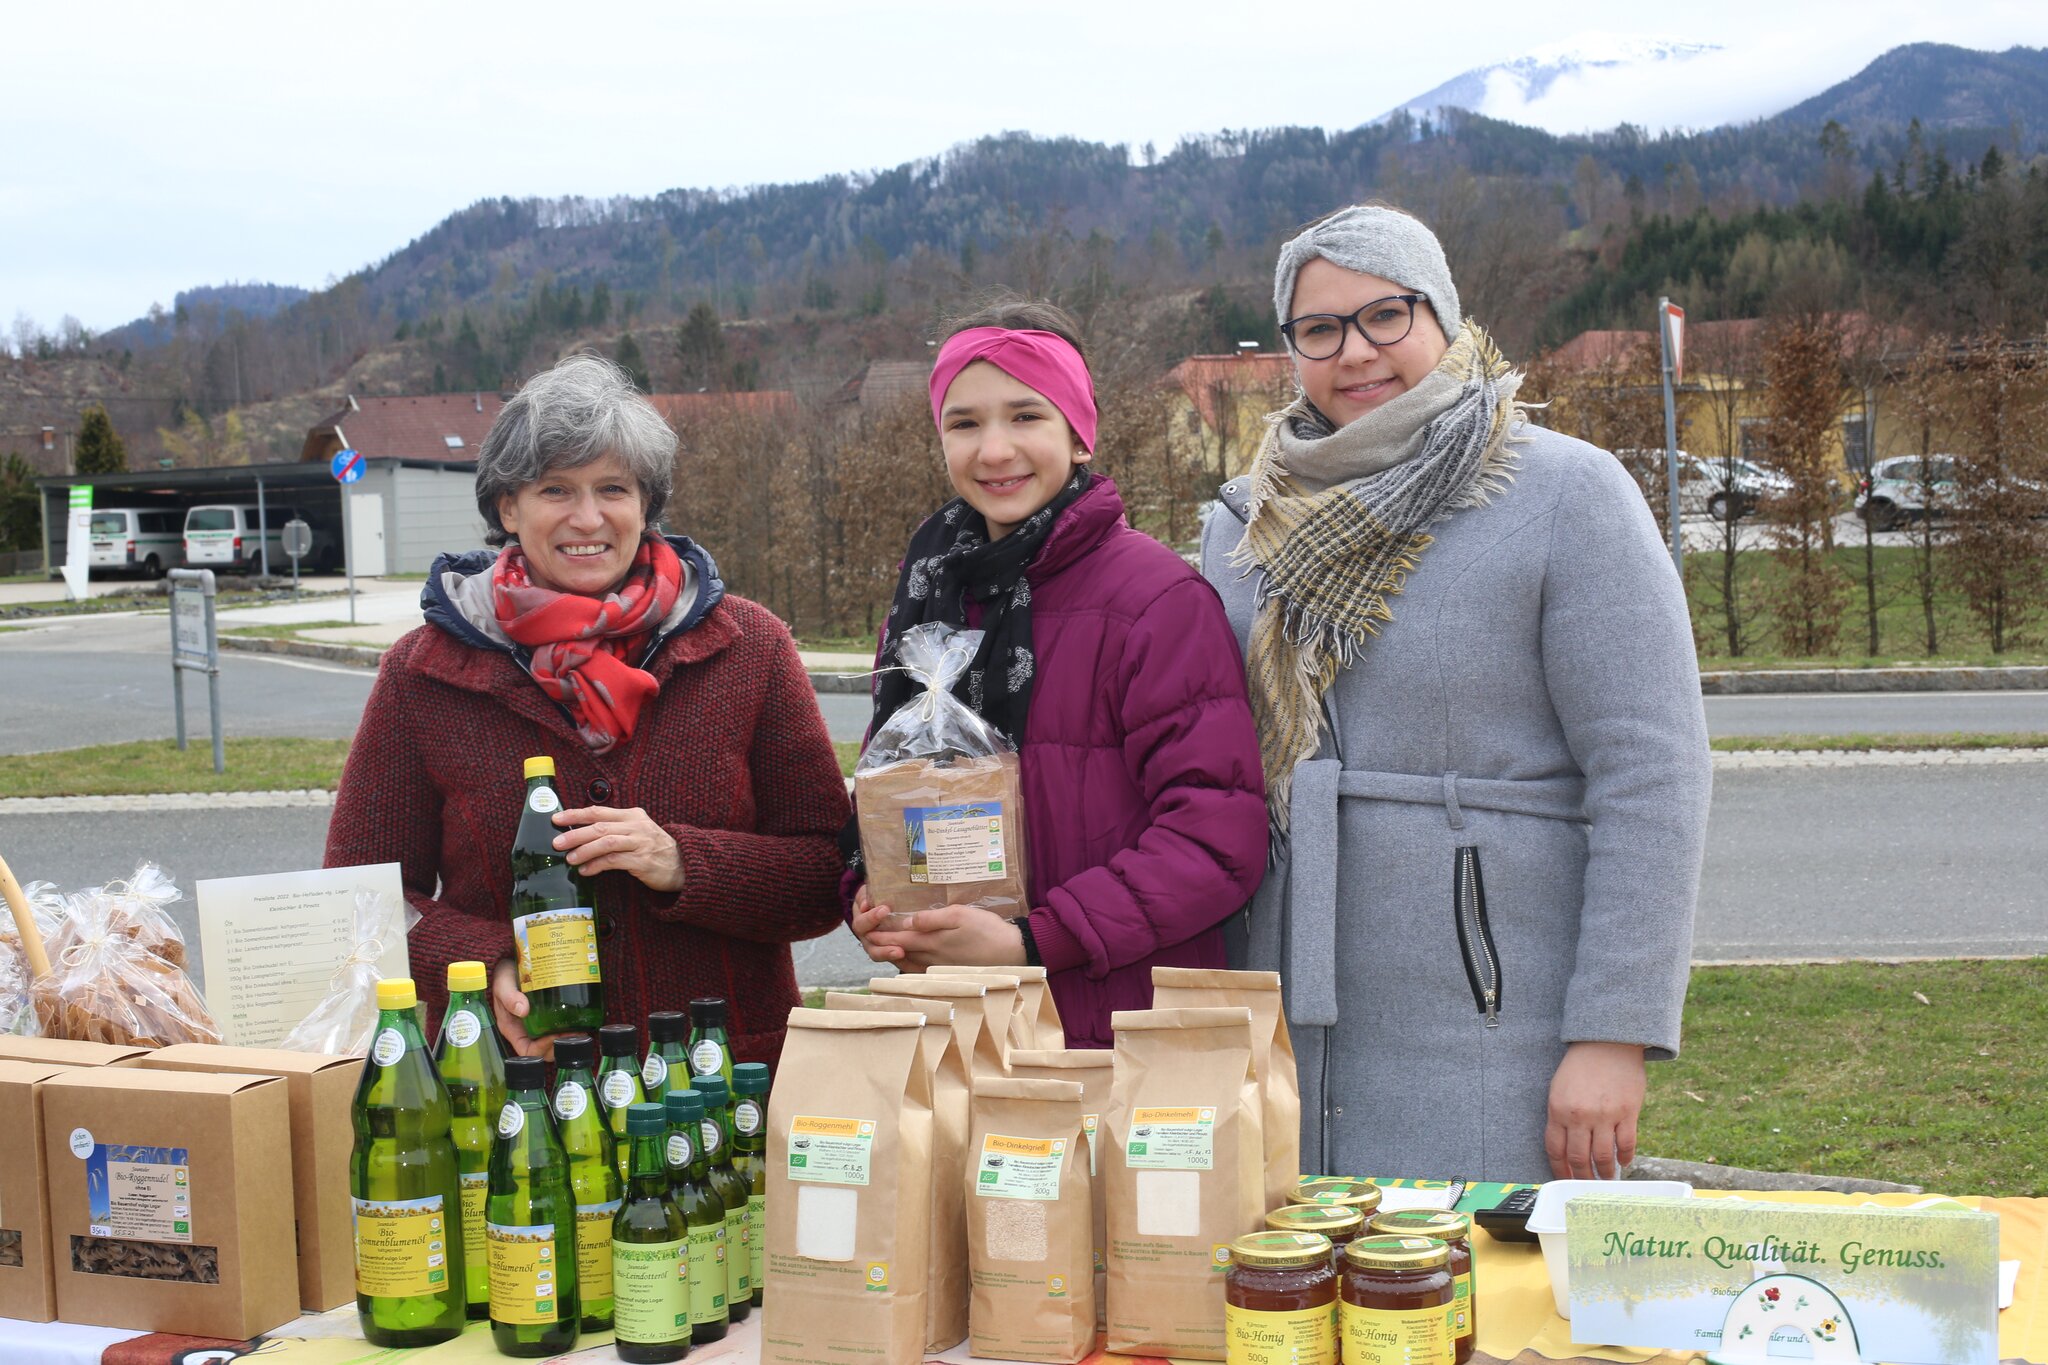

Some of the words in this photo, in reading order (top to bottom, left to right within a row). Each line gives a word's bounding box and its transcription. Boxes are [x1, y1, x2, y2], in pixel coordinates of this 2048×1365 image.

[1141, 1111, 1194, 1119] Bio-Dinkelmehl
[796, 1119, 854, 1131] Bio-Roggenmehl
[992, 1139, 1046, 1152] Bio-Dinkelgrieß
[1187, 1156, 1209, 1165] 1000g
[844, 1171, 865, 1181] 1000g
[1034, 1187, 1050, 1196] 500g
[1602, 1231, 1693, 1259] Natur.
[1703, 1234, 1827, 1269] Qualität.
[1839, 1240, 1946, 1275] Genuss.
[1234, 1326, 1286, 1347] Bio-Honig
[1349, 1324, 1398, 1345] Bio-Honig
[1786, 1334, 1804, 1343] und
[1247, 1352, 1269, 1365] 500g
[1360, 1350, 1382, 1364] 500g
